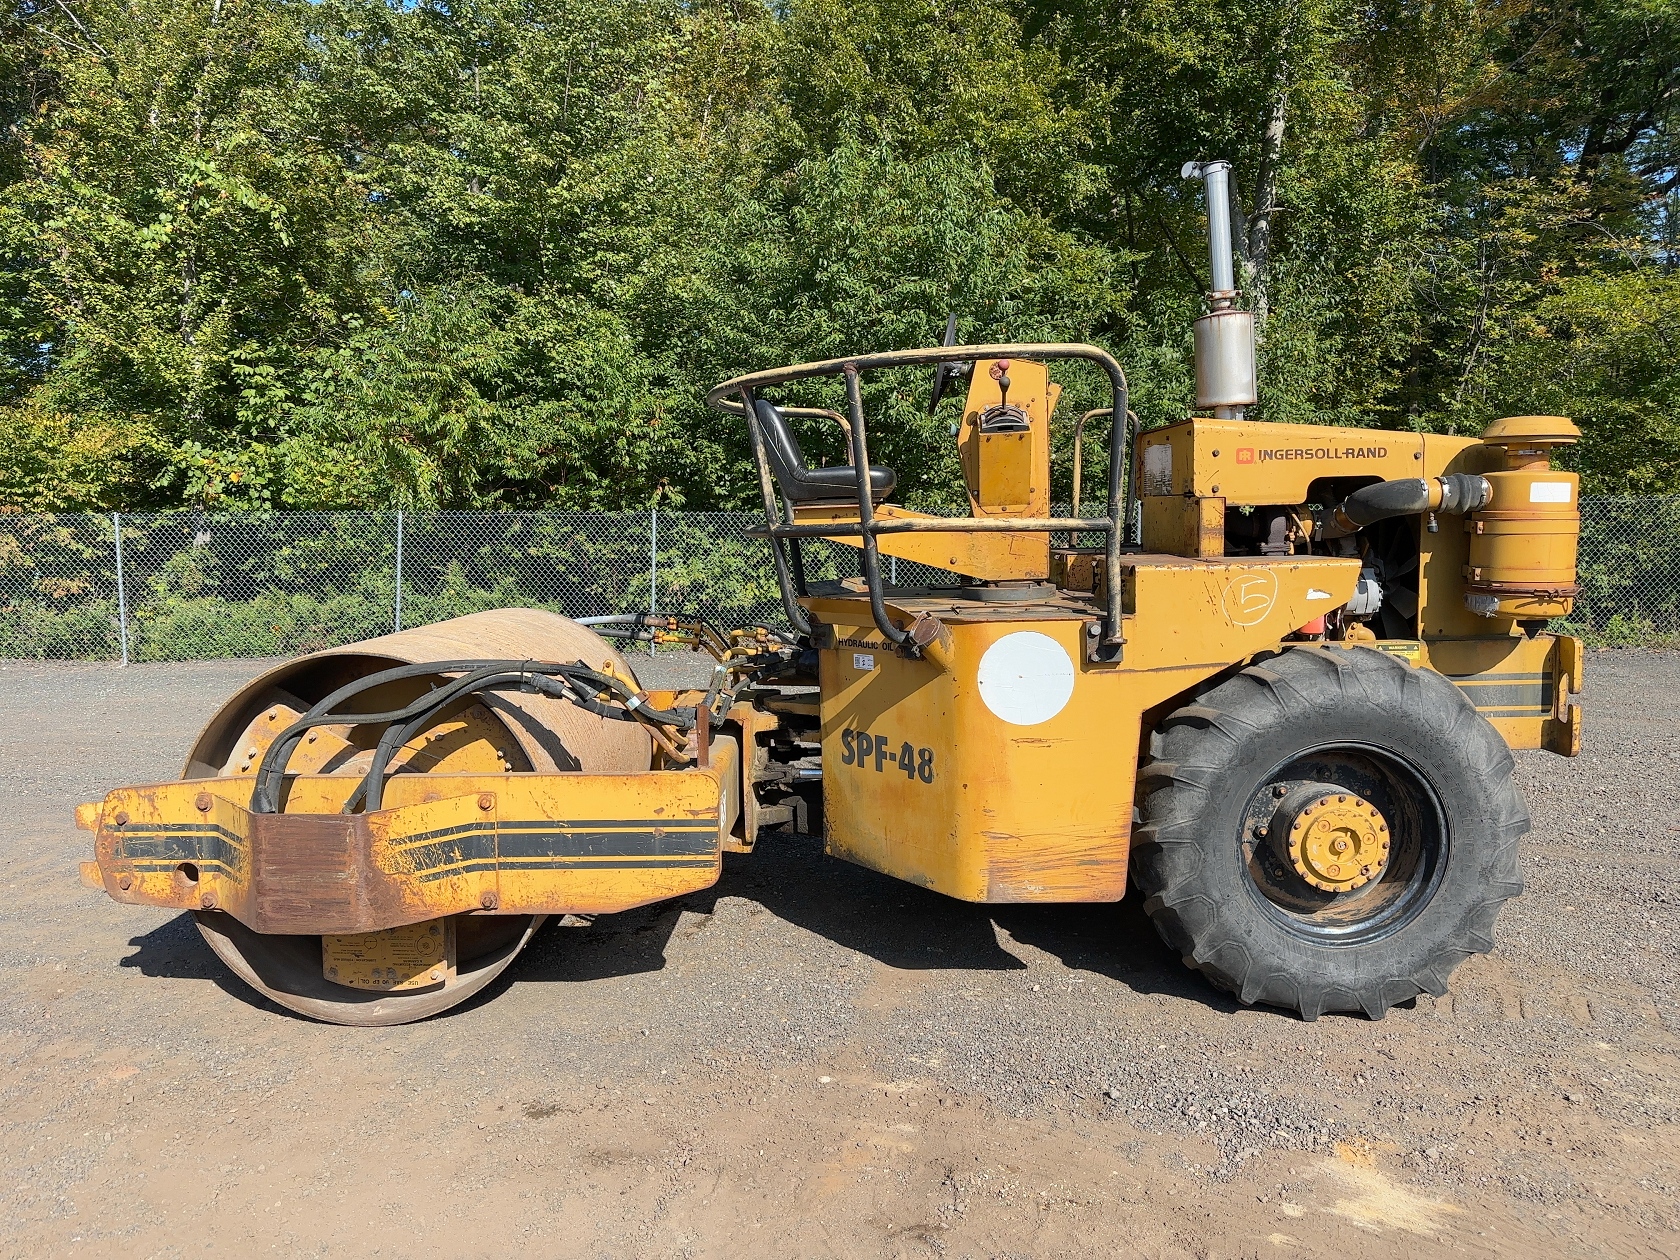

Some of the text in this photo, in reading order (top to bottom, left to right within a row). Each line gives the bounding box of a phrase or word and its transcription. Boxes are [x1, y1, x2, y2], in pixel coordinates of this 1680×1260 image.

[1258, 447, 1388, 461] INGERSOLL-RAND
[1241, 579, 1270, 613] 5
[838, 638, 894, 652] HYDRAULIC OIL
[841, 728, 935, 784] SPF-48
